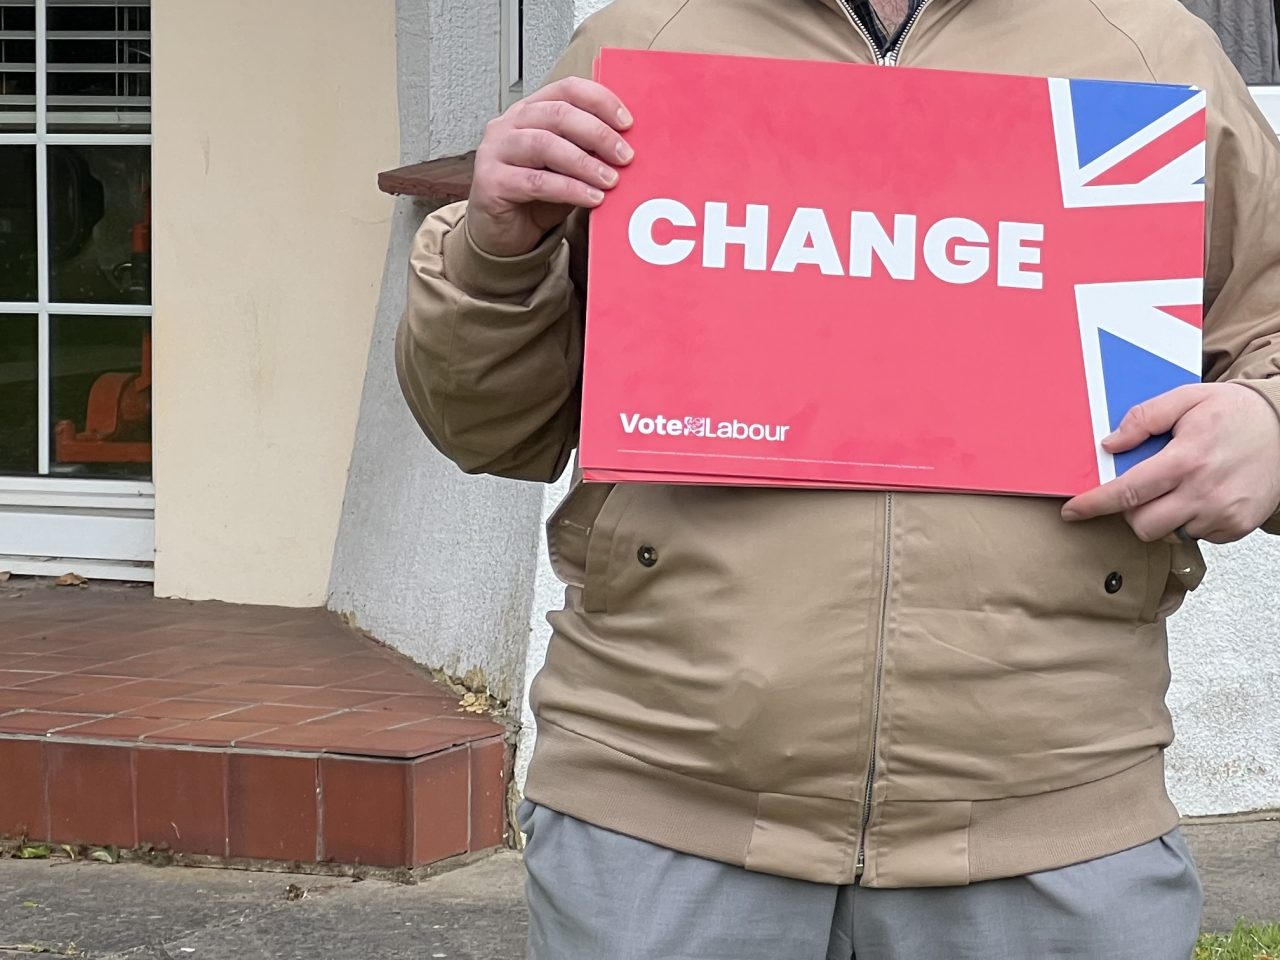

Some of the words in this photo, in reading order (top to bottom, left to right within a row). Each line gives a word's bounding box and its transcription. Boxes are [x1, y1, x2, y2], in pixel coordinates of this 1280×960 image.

[628, 198, 1044, 290] CHANGE
[620, 413, 683, 437] Vote
[706, 417, 790, 442] Labour
